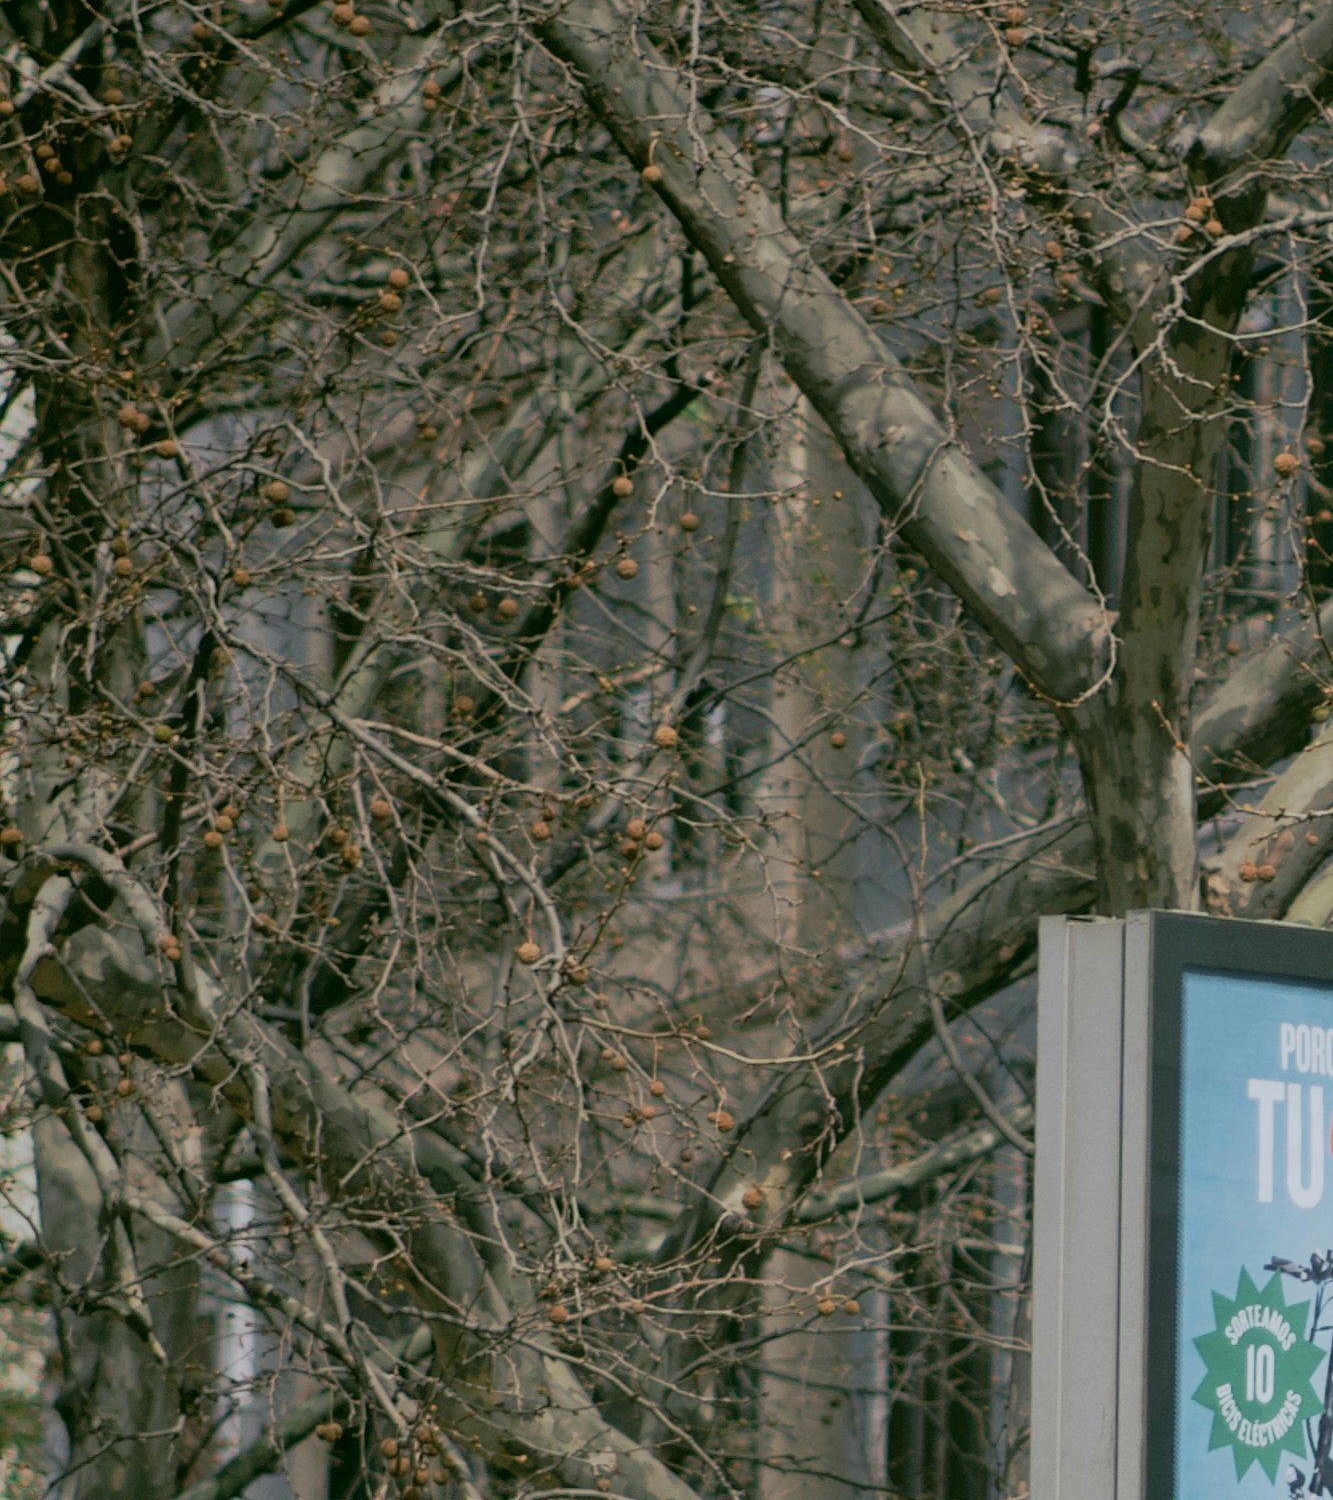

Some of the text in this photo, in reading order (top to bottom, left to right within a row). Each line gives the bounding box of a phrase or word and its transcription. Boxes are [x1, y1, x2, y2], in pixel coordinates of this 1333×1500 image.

[1248, 1078, 1324, 1209] TU
[1225, 1304, 1296, 1351] SORTEAMOS
[1246, 1344, 1275, 1403] 10
[1216, 1383, 1302, 1447] BICIS ELÉCTRICAS
